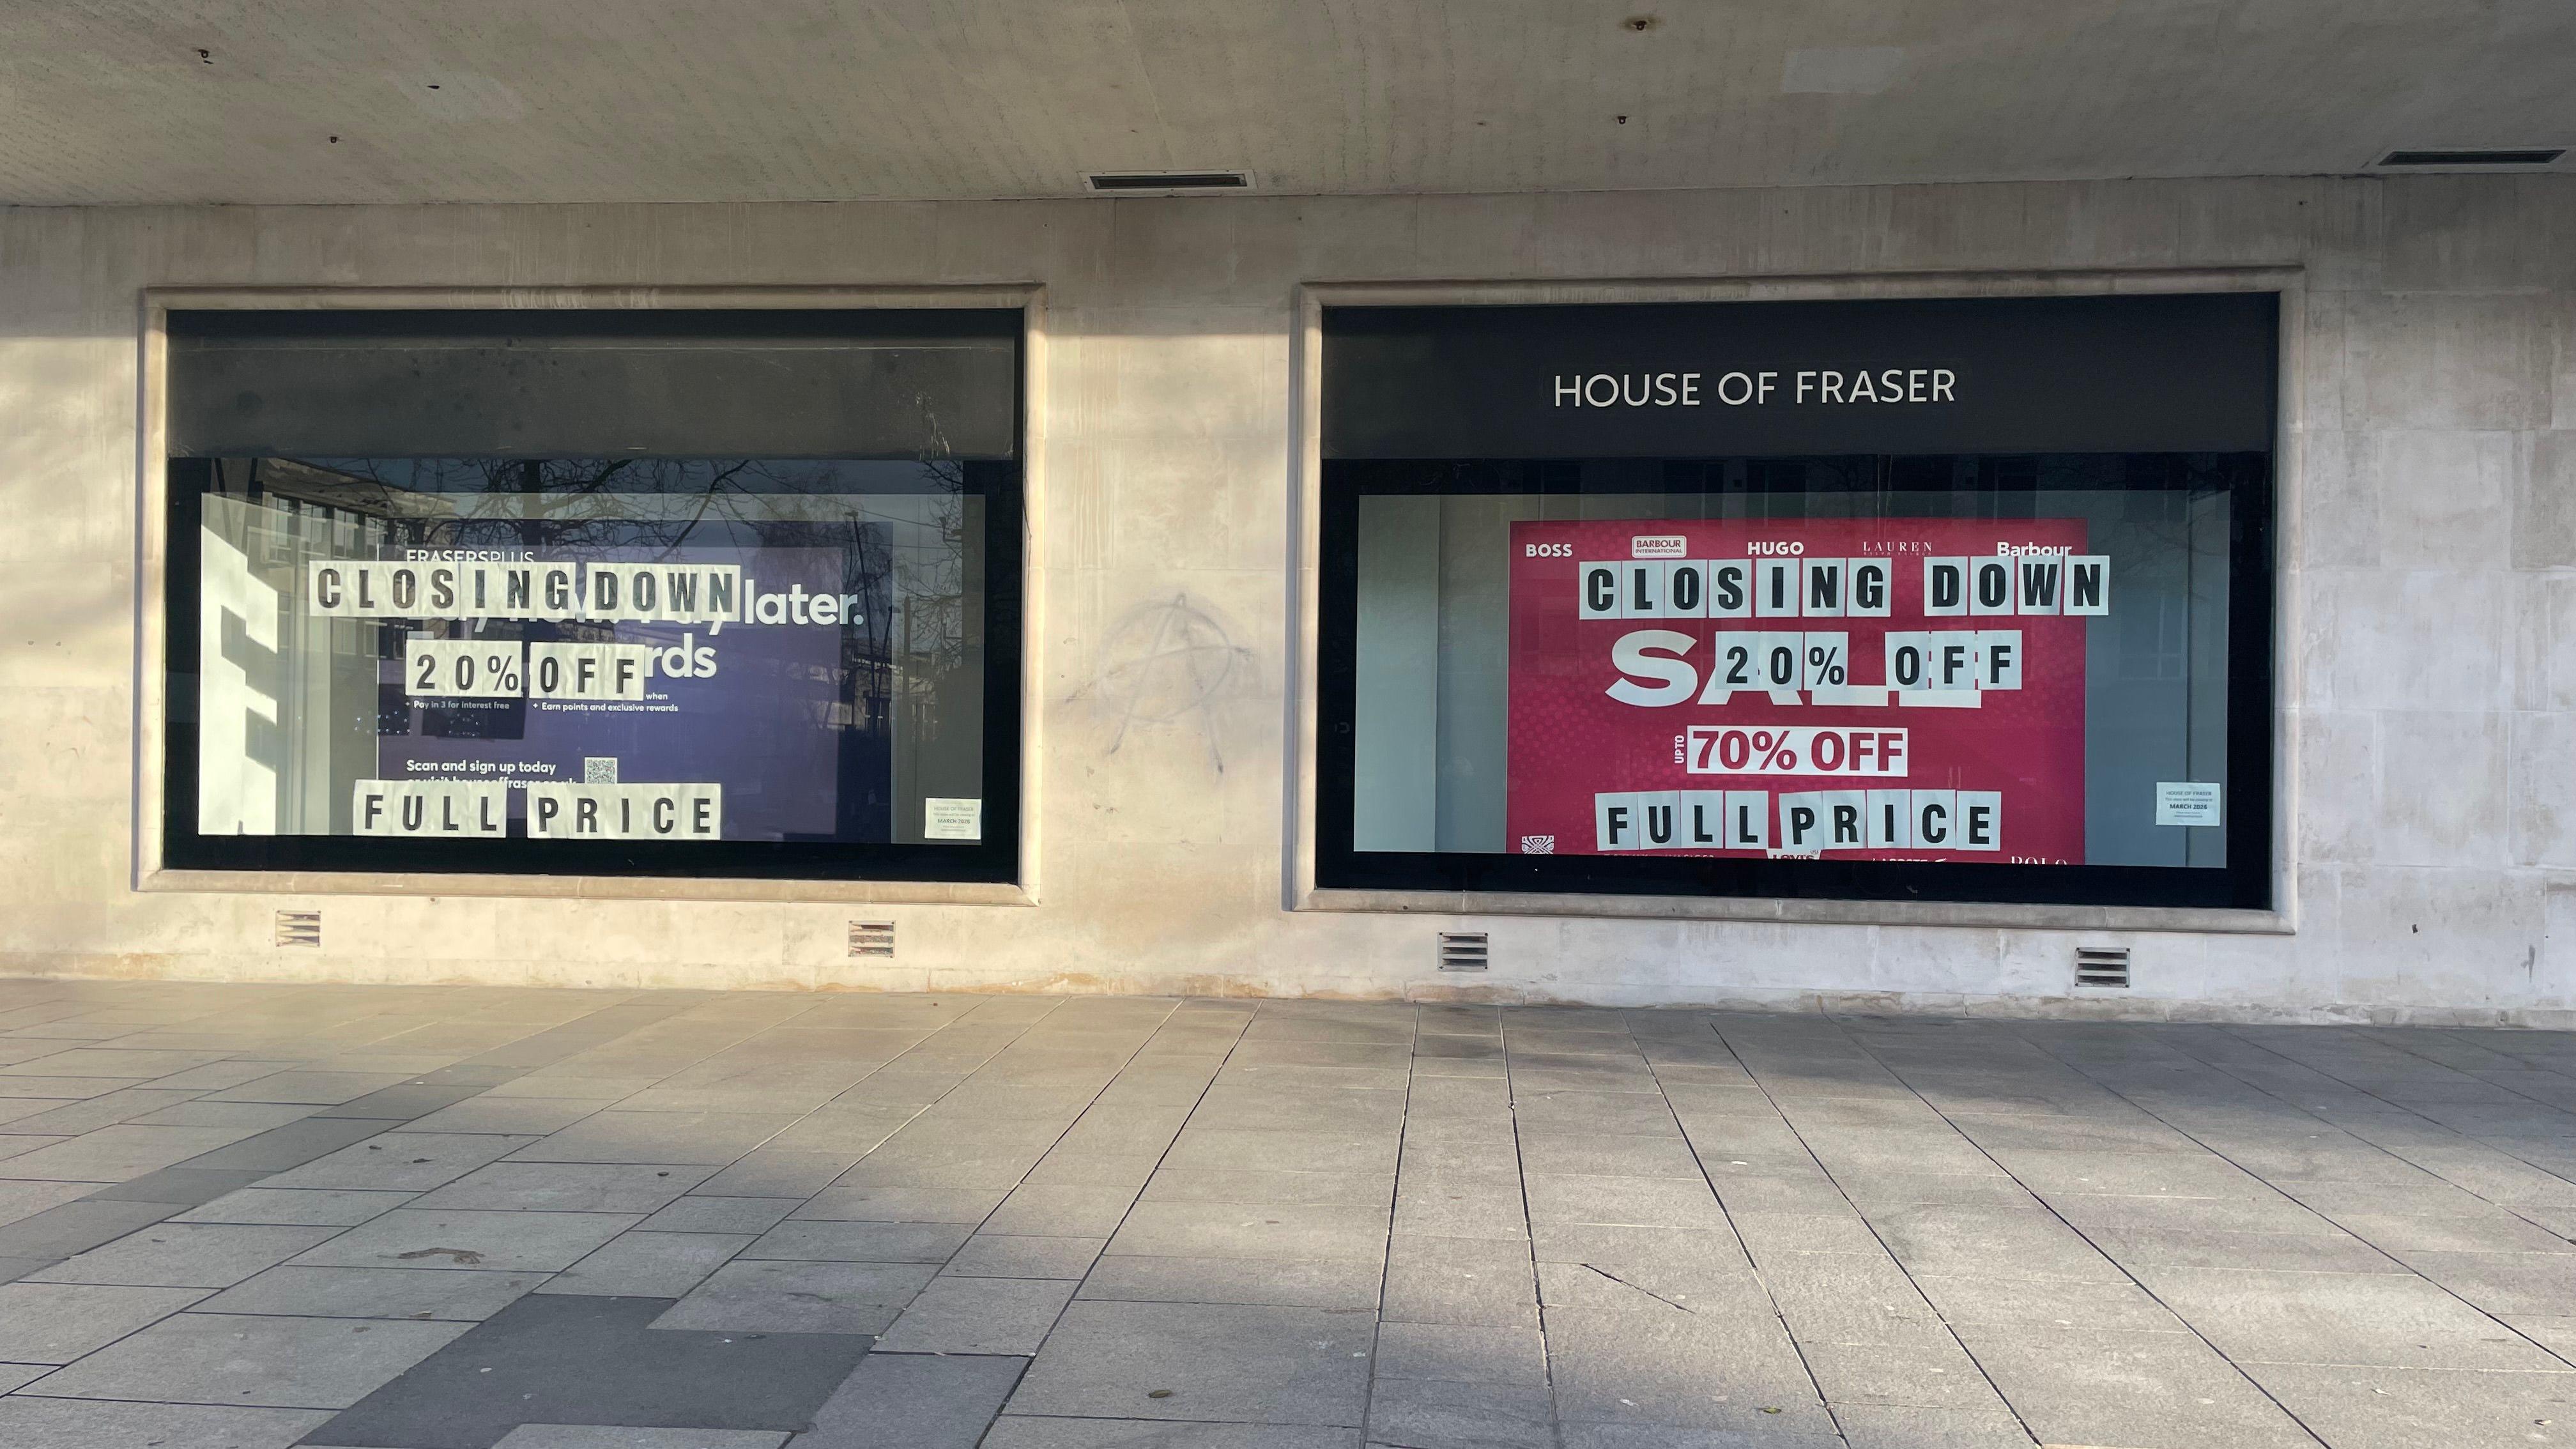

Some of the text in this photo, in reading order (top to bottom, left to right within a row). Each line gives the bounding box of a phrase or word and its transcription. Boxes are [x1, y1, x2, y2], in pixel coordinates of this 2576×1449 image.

[1555, 368, 1956, 408] HOUSE OF FRASER
[1526, 543, 1573, 558] BOSS
[1747, 541, 1804, 556] HUGO
[1863, 541, 1932, 552] LAUREN
[1997, 541, 2073, 556] Barbour
[318, 568, 732, 613] CLOSING DOWN
[744, 579, 864, 625] later.
[1587, 563, 2100, 611] CLOSING DOWN
[416, 654, 519, 692] 20%
[539, 656, 634, 694] OFF
[1726, 645, 1845, 686] 20%
[1895, 645, 2012, 685] OFF
[413, 700, 429, 712] Pay
[493, 702, 510, 710] free
[541, 702, 678, 712] Earn points and exclusive rewards
[646, 692, 668, 700] when
[406, 760, 556, 776] Scan and sign up today
[1692, 730, 1903, 772] 70% OFF
[365, 794, 712, 834] FULL PRICE
[1607, 804, 1990, 845] FULL PRICE
